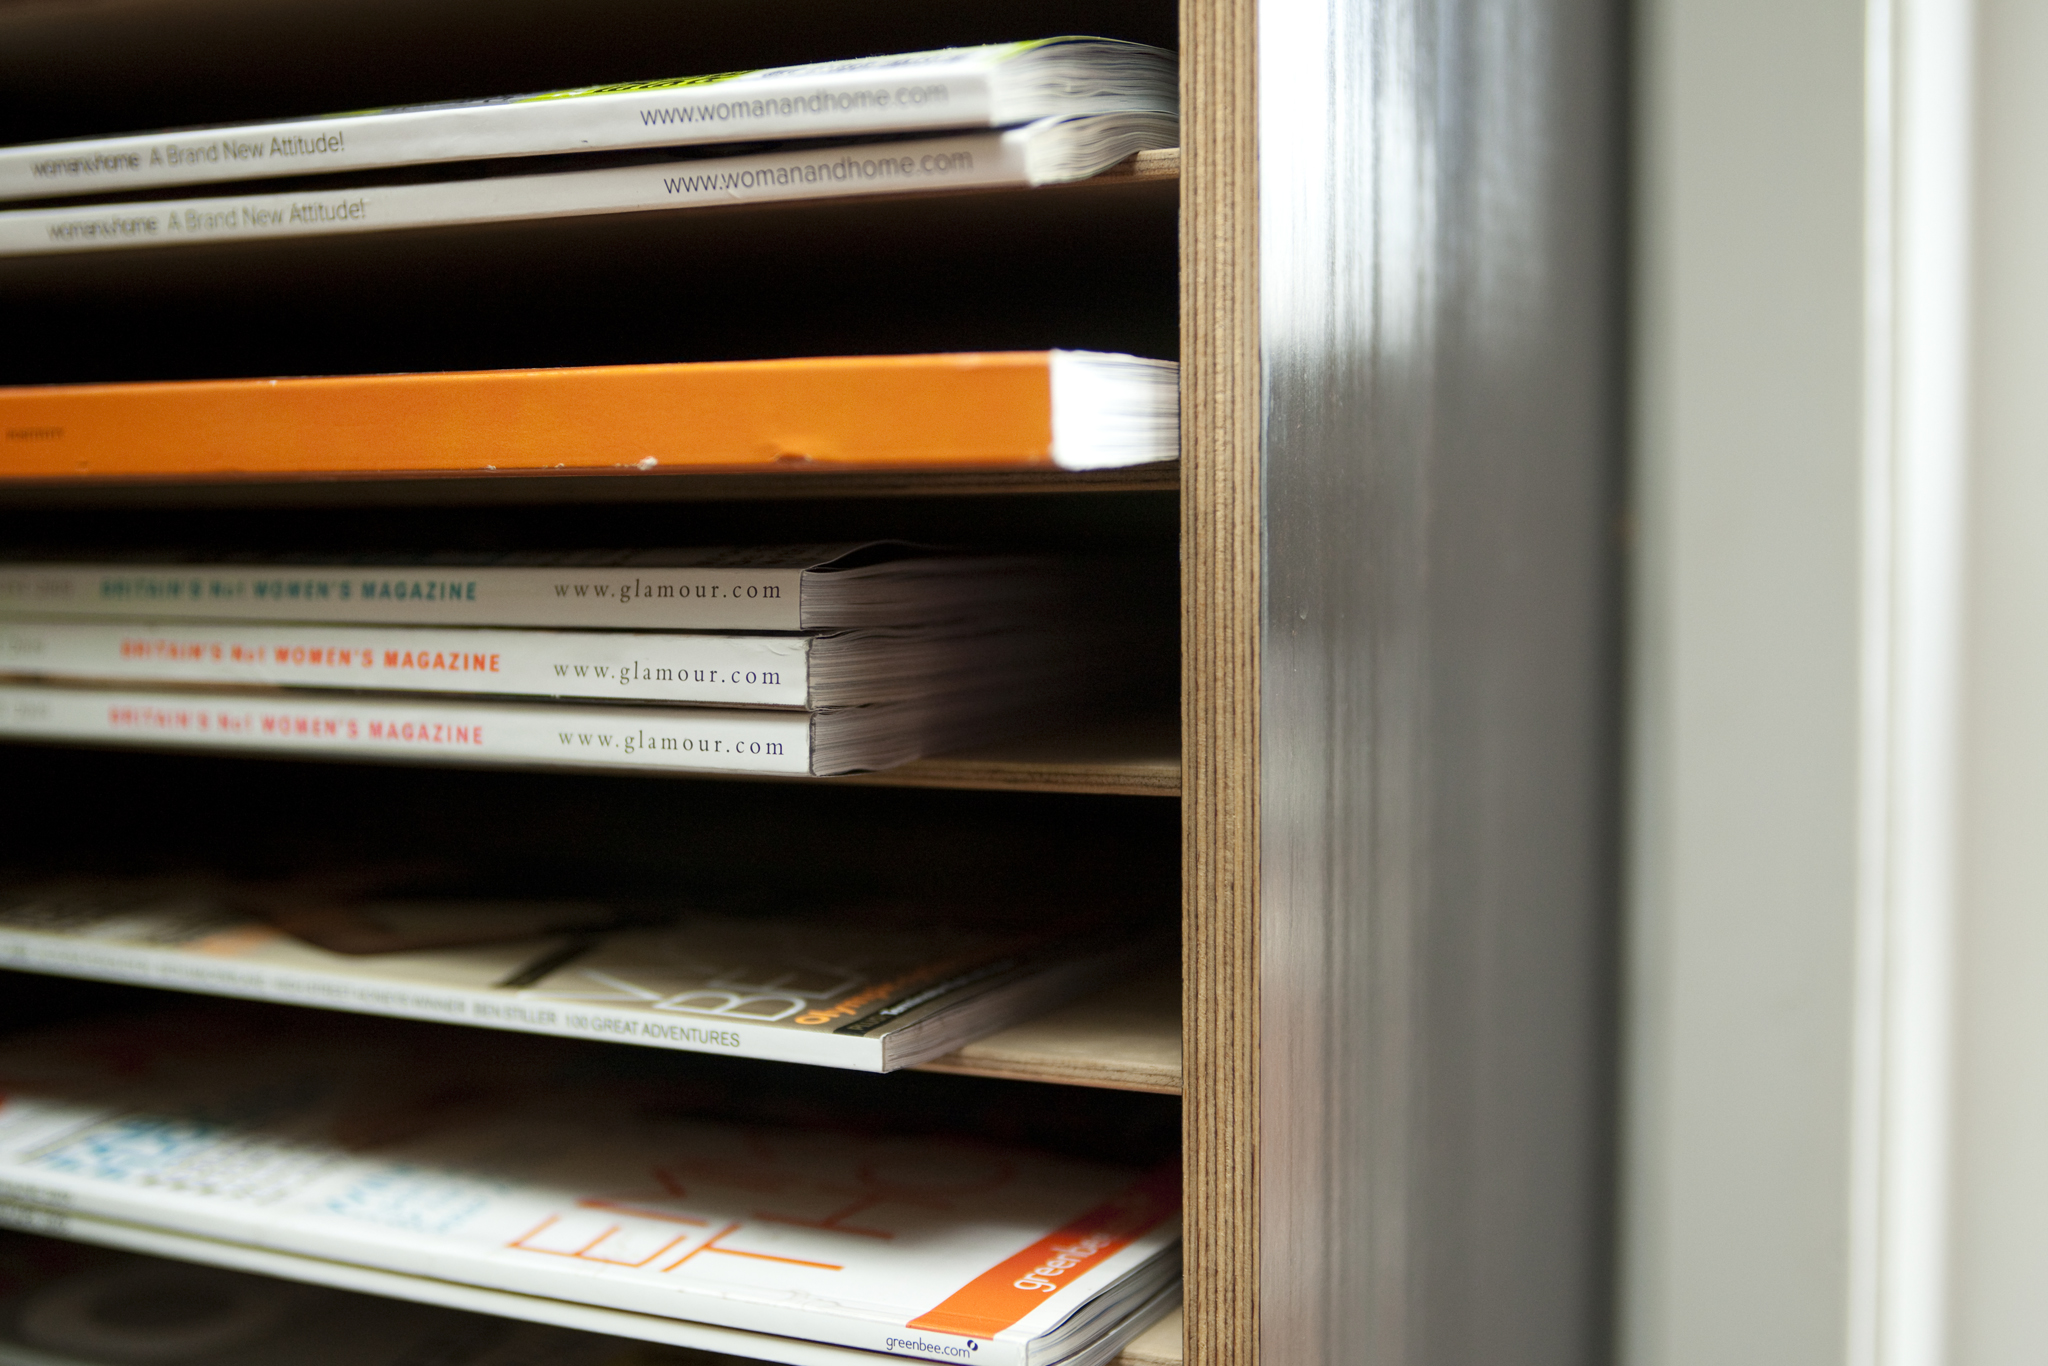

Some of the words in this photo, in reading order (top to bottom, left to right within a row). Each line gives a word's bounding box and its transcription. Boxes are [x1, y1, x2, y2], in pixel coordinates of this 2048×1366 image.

[640, 83, 948, 126] www.womanandhome.com
[150, 147, 162, 166] A
[167, 142, 217, 165] Brand
[223, 139, 264, 160] New
[269, 131, 345, 157] Attitude!
[664, 150, 974, 195] www.womanandhome.com
[168, 210, 182, 232] A
[185, 206, 236, 231] Brand
[243, 204, 283, 225] New
[289, 198, 366, 222] Attitude!
[361, 580, 477, 601] MAGAZINE
[554, 578, 781, 603] www.glamour.com
[274, 645, 373, 668] WOMEN'S
[383, 650, 500, 672] MAGAZINE
[554, 661, 781, 685] www.glamour.com
[369, 720, 483, 745] MAGAZINE
[558, 730, 784, 756] www.glamour.com
[591, 1015, 638, 1035] GREAT
[642, 1022, 740, 1048] ADVENTURES
[886, 1337, 970, 1358] greenbee.com
